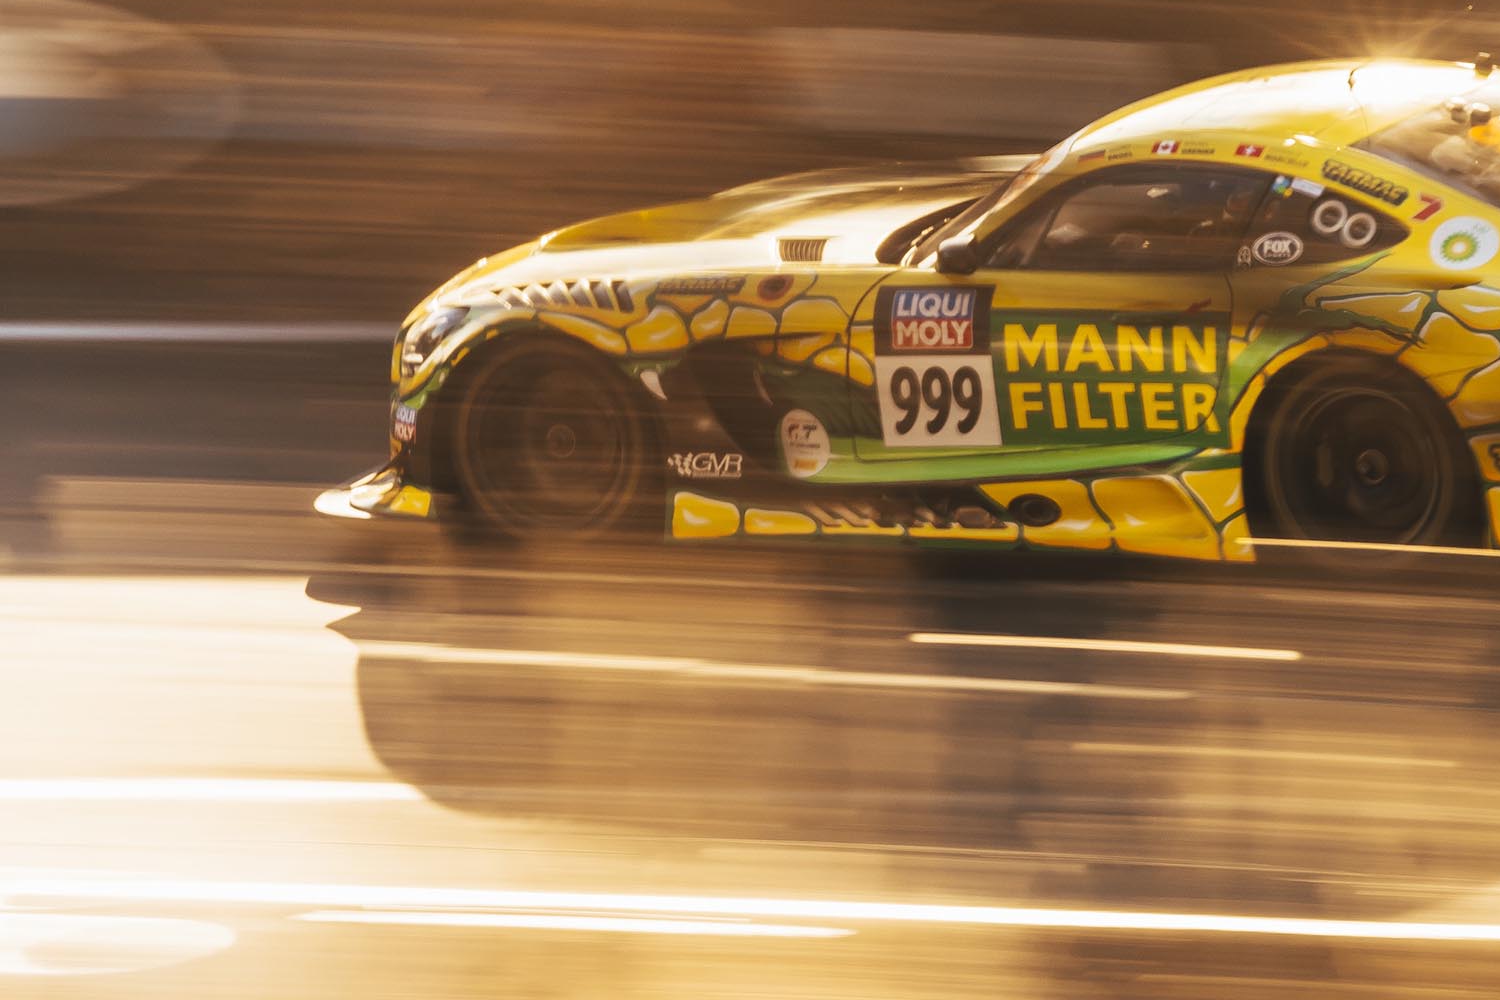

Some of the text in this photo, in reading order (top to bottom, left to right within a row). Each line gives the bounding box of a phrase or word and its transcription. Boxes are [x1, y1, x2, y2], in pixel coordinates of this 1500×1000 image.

[1412, 193, 1443, 221] 7
[1263, 240, 1291, 254] FOX
[896, 293, 971, 317] LIQUI
[896, 320, 970, 345] MOLY
[1004, 324, 1217, 373] MANN
[890, 366, 983, 435] 999
[1009, 382, 1221, 432] FILTER
[692, 453, 743, 471] GMR
